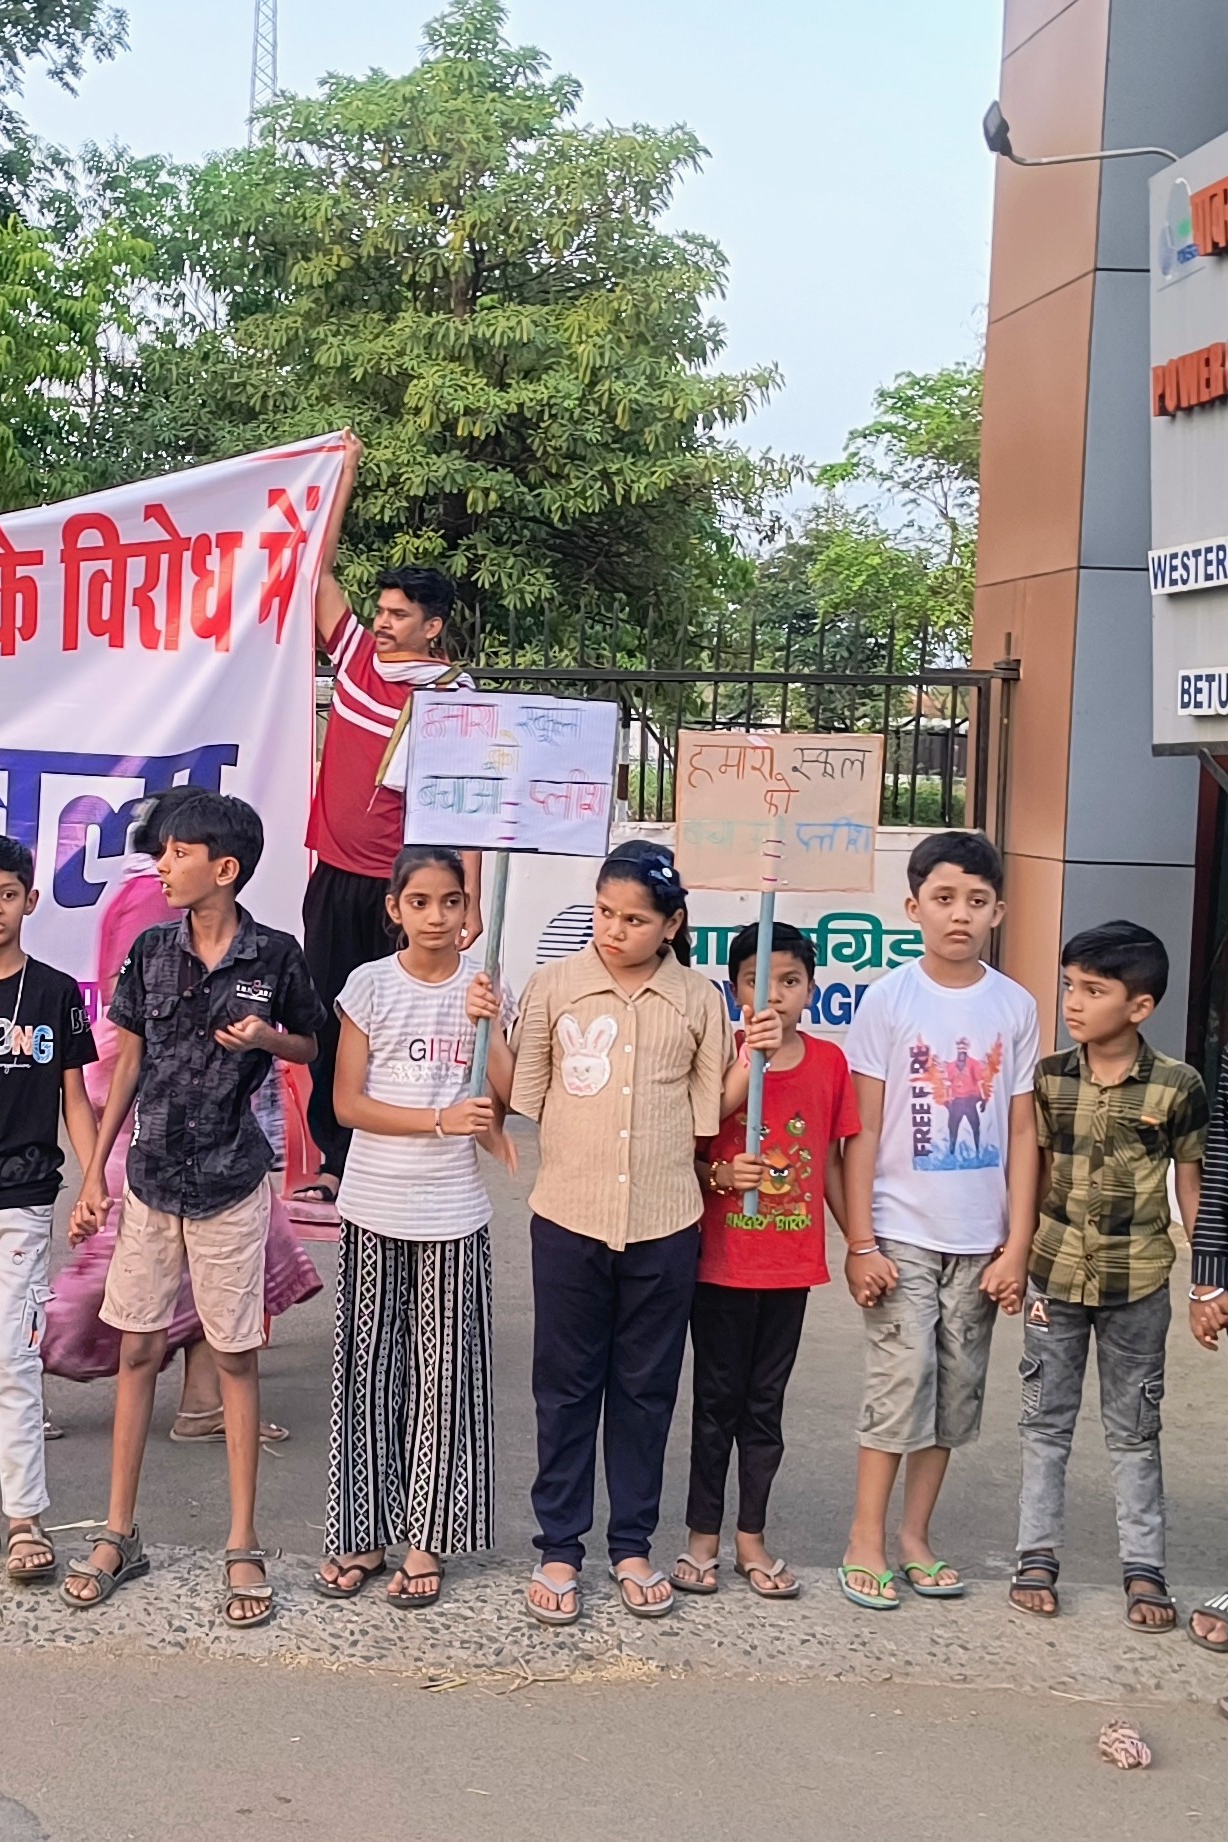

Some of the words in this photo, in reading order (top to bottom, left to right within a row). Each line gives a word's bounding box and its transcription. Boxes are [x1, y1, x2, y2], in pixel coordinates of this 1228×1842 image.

[1152, 342, 1228, 417] POWER
[60, 503, 243, 652] विरोध
[258, 485, 320, 645] में
[909, 1045, 933, 1098] FRE
[912, 1102, 933, 1157] FREE
